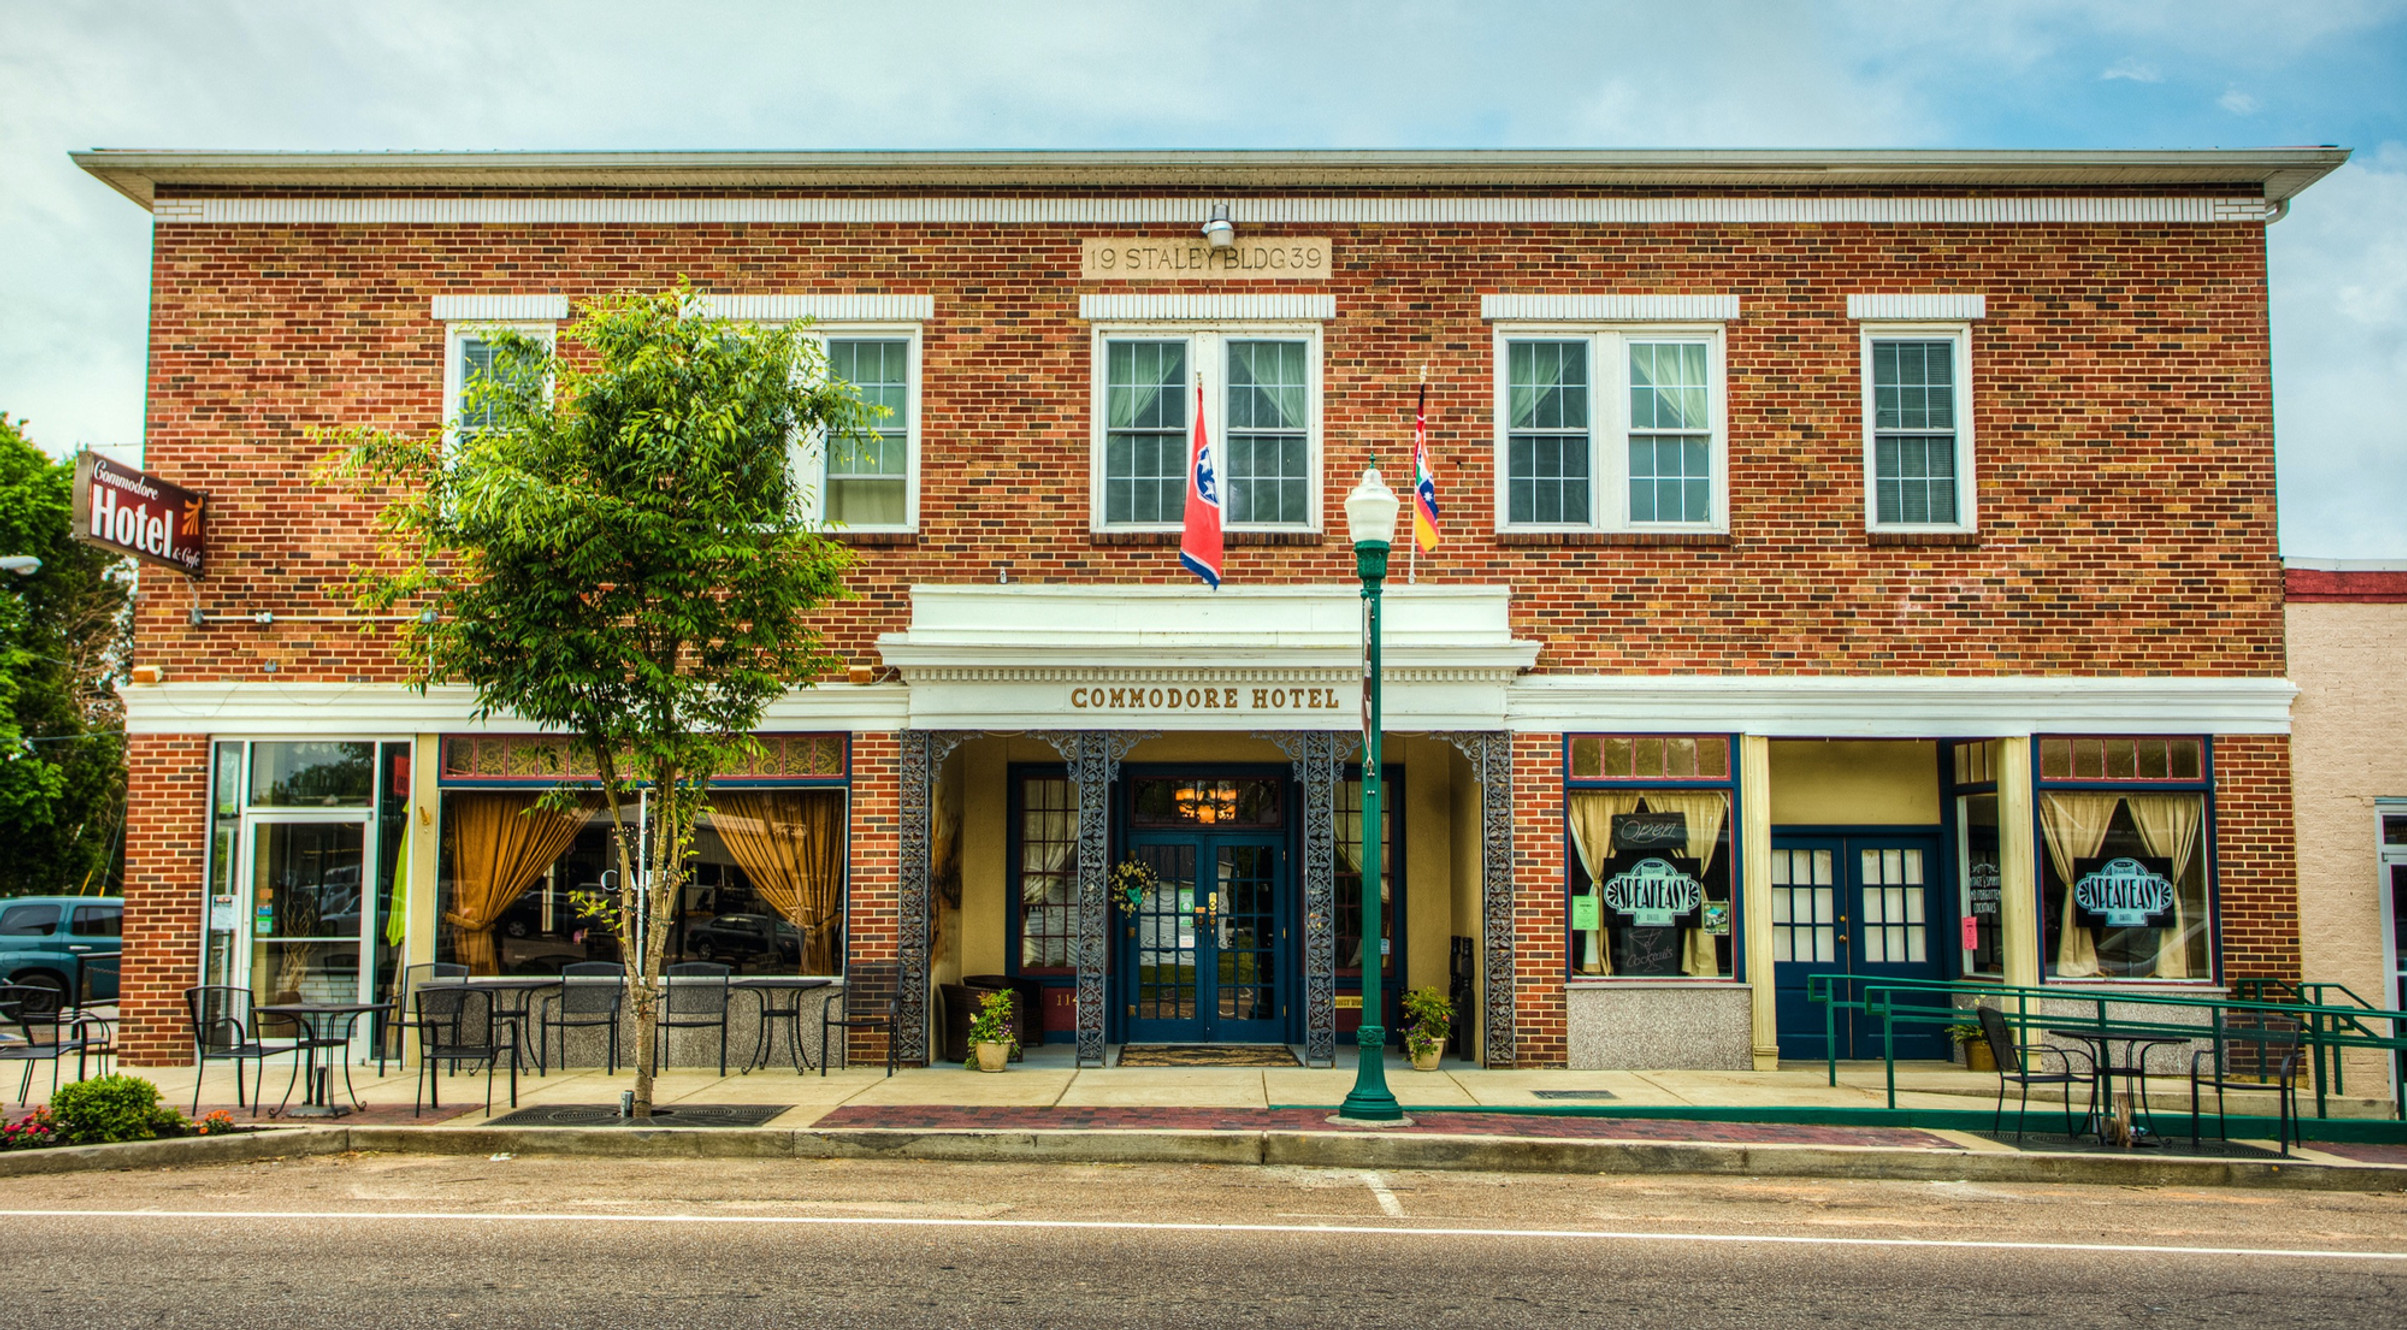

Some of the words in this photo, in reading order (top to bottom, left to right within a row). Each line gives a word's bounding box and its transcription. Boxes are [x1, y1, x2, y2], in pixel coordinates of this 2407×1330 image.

[1090, 247, 1116, 270] 19
[1125, 247, 1217, 270] STALEY
[1223, 247, 1285, 270] BLDG
[1290, 247, 1322, 270] 39
[93, 459, 159, 501] Commodore
[91, 483, 174, 559] Hotel
[172, 547, 181, 560] &
[1071, 687, 1238, 708] COMMODORE
[1252, 687, 1339, 708] HOTEL
[1621, 819, 1678, 844] Open
[1618, 876, 1690, 910] SPEAKEASY
[2090, 877, 2161, 910] SPEAKEASY
